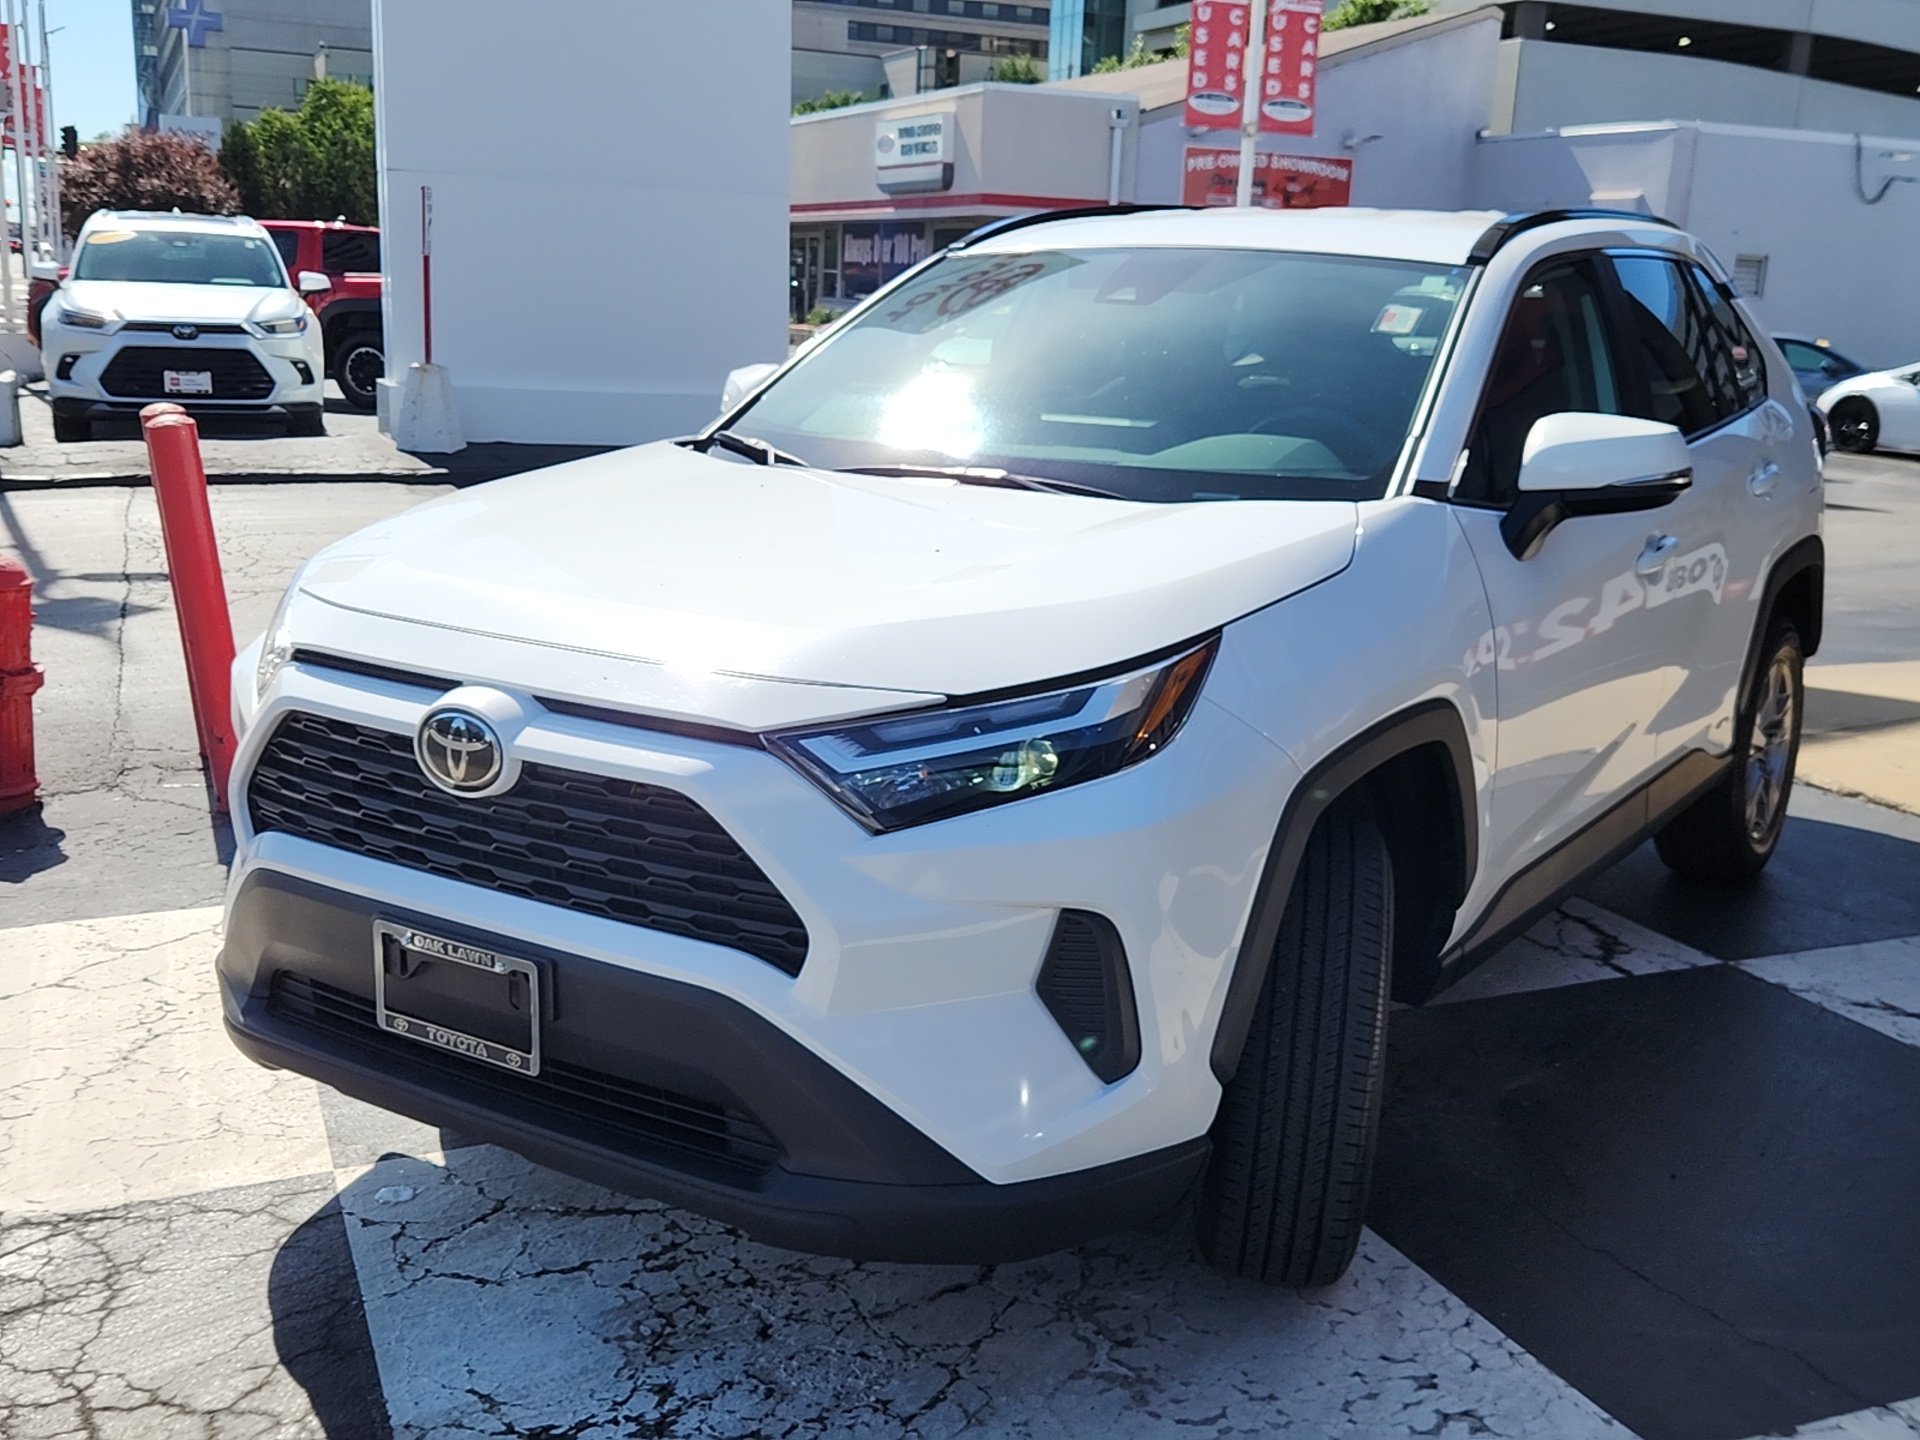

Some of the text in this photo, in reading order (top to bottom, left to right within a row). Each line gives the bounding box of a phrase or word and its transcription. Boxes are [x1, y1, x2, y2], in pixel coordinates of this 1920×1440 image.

[1192, 5, 1213, 88] USED
[1224, 8, 1245, 91] CARS
[1265, 13, 1287, 95] USED
[1298, 16, 1318, 98] CARS
[413, 934, 493, 967] OAK LAWN
[426, 1026, 488, 1058] TOYOTA
